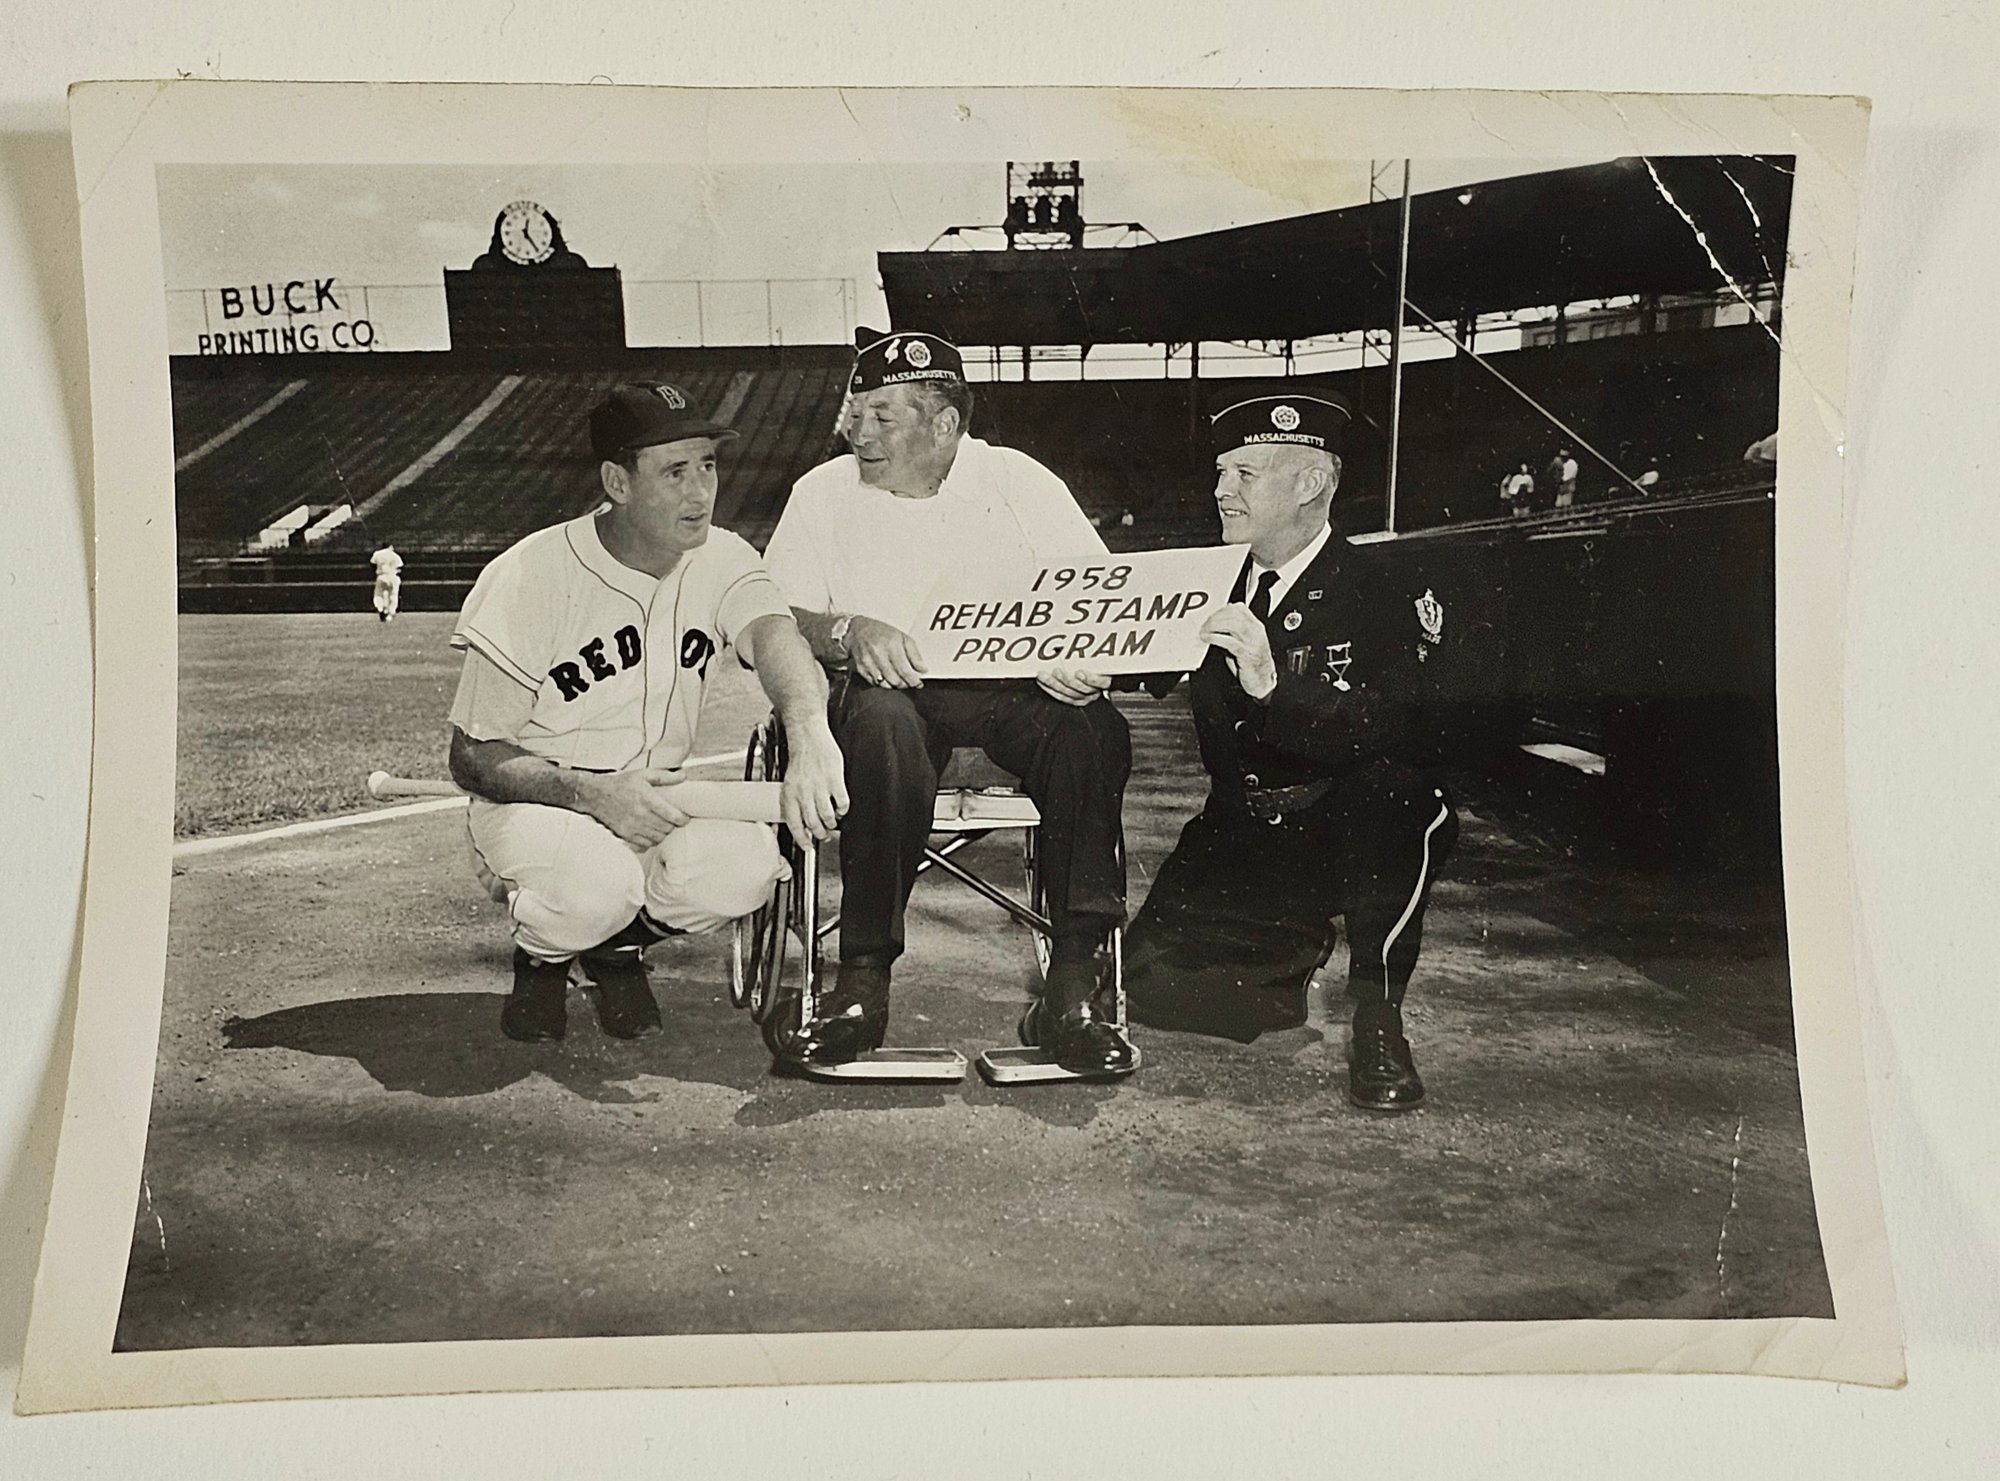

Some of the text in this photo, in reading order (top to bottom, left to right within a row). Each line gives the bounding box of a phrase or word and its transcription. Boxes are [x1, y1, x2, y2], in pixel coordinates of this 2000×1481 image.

[221, 278, 340, 319] BUCK
[199, 320, 379, 355] PRINTING CO.
[882, 369, 957, 384] MASSACHUSETTS
[1244, 433, 1325, 447] MASSACHUSETTS
[1031, 565, 1133, 593] 1958
[929, 591, 1209, 631] REHAB STAMP
[952, 629, 1156, 663] PROGRAM
[548, 625, 642, 702] RED
